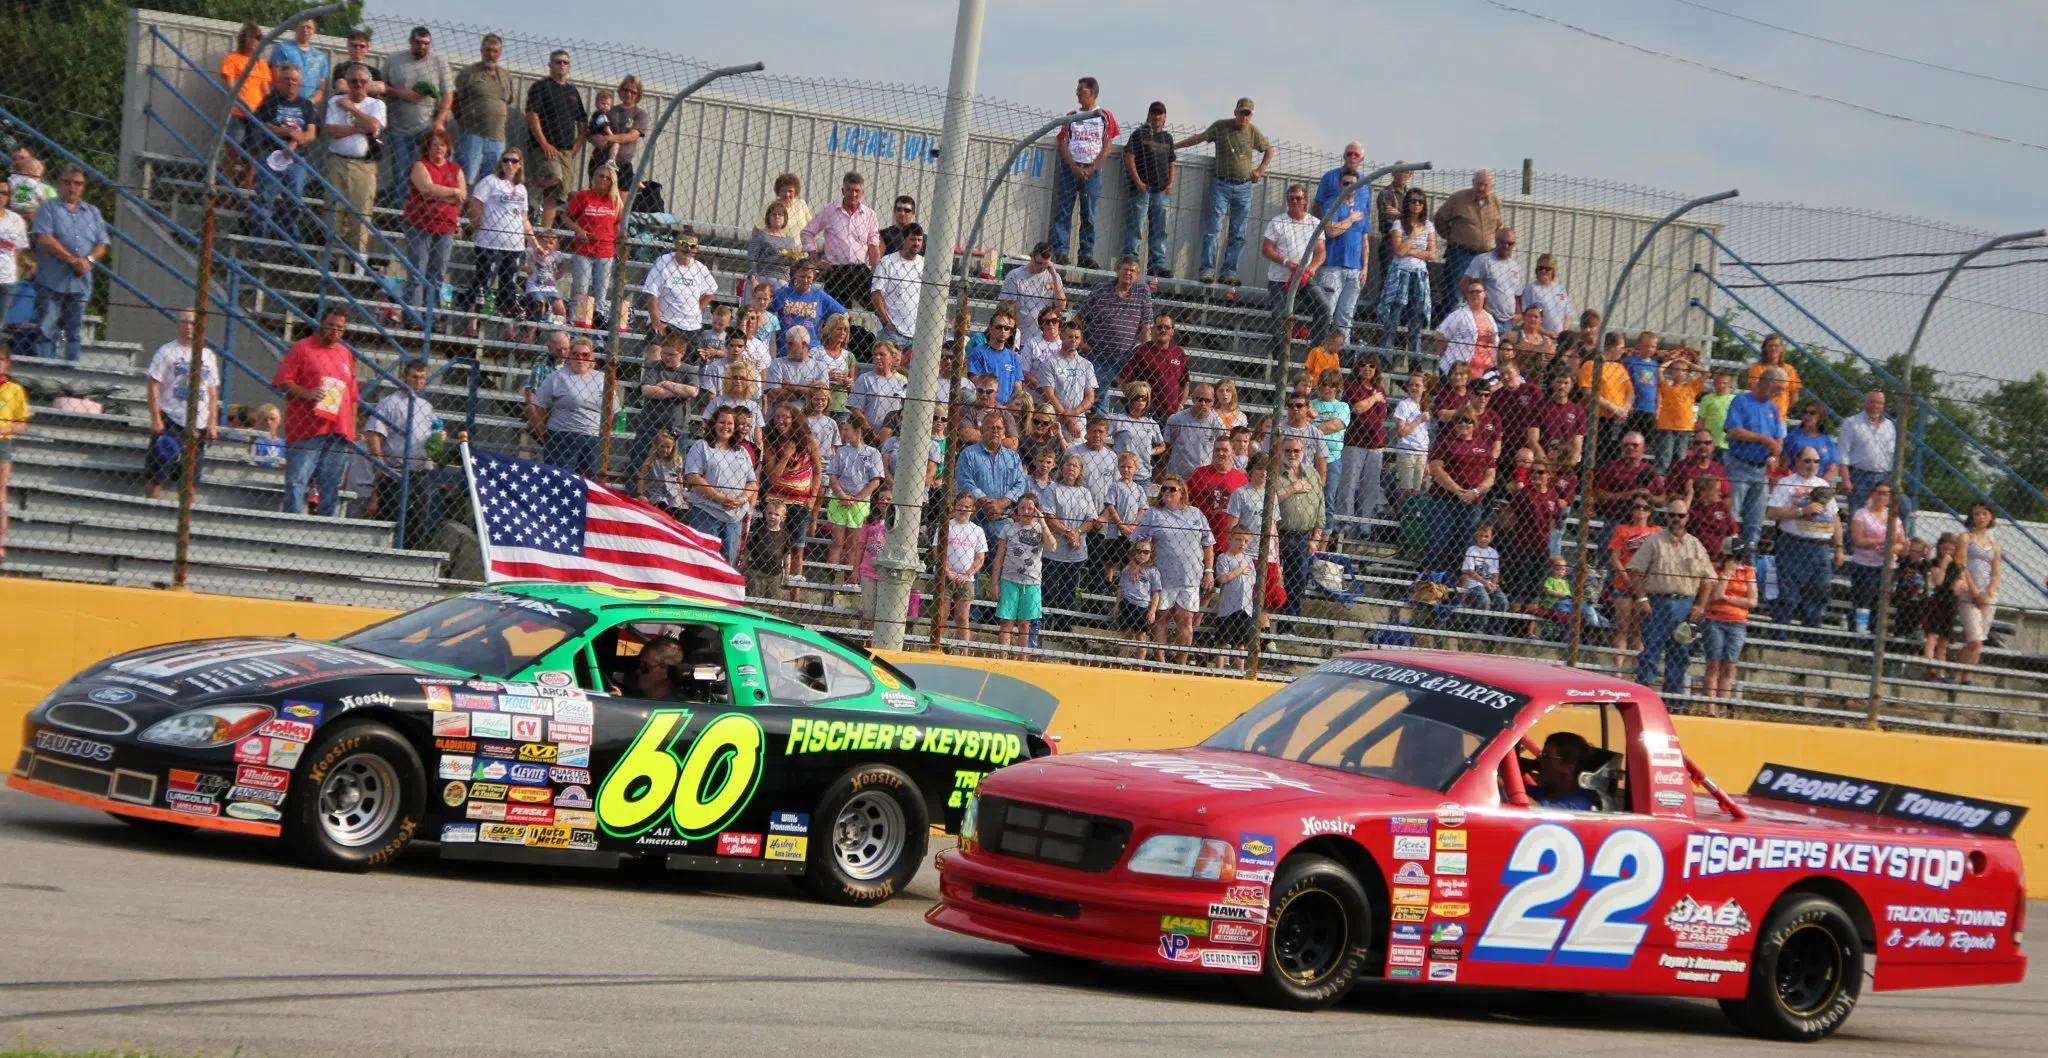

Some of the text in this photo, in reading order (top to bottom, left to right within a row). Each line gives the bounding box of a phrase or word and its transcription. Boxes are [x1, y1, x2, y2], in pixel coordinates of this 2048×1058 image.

[542, 687, 569, 697] ARCA
[1373, 665, 1424, 684] CARS
[1420, 677, 1439, 690] &
[1437, 679, 1516, 710] PARTS
[339, 691, 397, 712] Hoosier
[516, 720, 537, 736] CV
[36, 730, 114, 761] TAURUS
[785, 718, 1021, 766] FISCHER'S KEYSTOP
[309, 736, 361, 784] Hoosier
[242, 768, 285, 784] Mallory
[511, 763, 546, 779] CLEVITE
[551, 768, 587, 777] QUARTER
[556, 774, 589, 784] MASTER
[596, 708, 766, 840] 60
[850, 772, 902, 793] Hoosier
[169, 792, 212, 804] LINCOLN
[948, 790, 962, 808] &
[1771, 772, 1994, 828] People's Towing
[510, 807, 550, 817] PENSKE
[491, 826, 527, 837] EARL'S
[540, 827, 565, 837] Auto
[653, 827, 671, 837] All
[770, 822, 807, 832] Transmission
[1301, 816, 1356, 836] Hoosier
[537, 835, 569, 845] Meter
[636, 836, 688, 847] American
[1243, 843, 1272, 853] SUNOCO
[1682, 833, 1966, 891] FISCHER'S KEYSTOP
[843, 879, 894, 900] Hoosier
[1228, 887, 1265, 900] KRC
[1468, 822, 1665, 969] 22
[1210, 905, 1247, 918] HAWK
[1669, 904, 1741, 926] JAB
[1886, 905, 2008, 928] TRUCKING-TOWING
[1217, 924, 1259, 938] Mallory
[1673, 923, 1740, 936] RACE CARS
[1689, 933, 1729, 944] PARTS
[1904, 931, 1946, 948] Auto
[1950, 932, 1997, 952] Repair
[1160, 934, 1189, 960] VP
[1205, 953, 1257, 966] SCHOENFELD
[1695, 956, 1746, 973] Automotive
[1317, 946, 1369, 1000] Hoosier
[1802, 988, 1856, 1033] Hoosier
